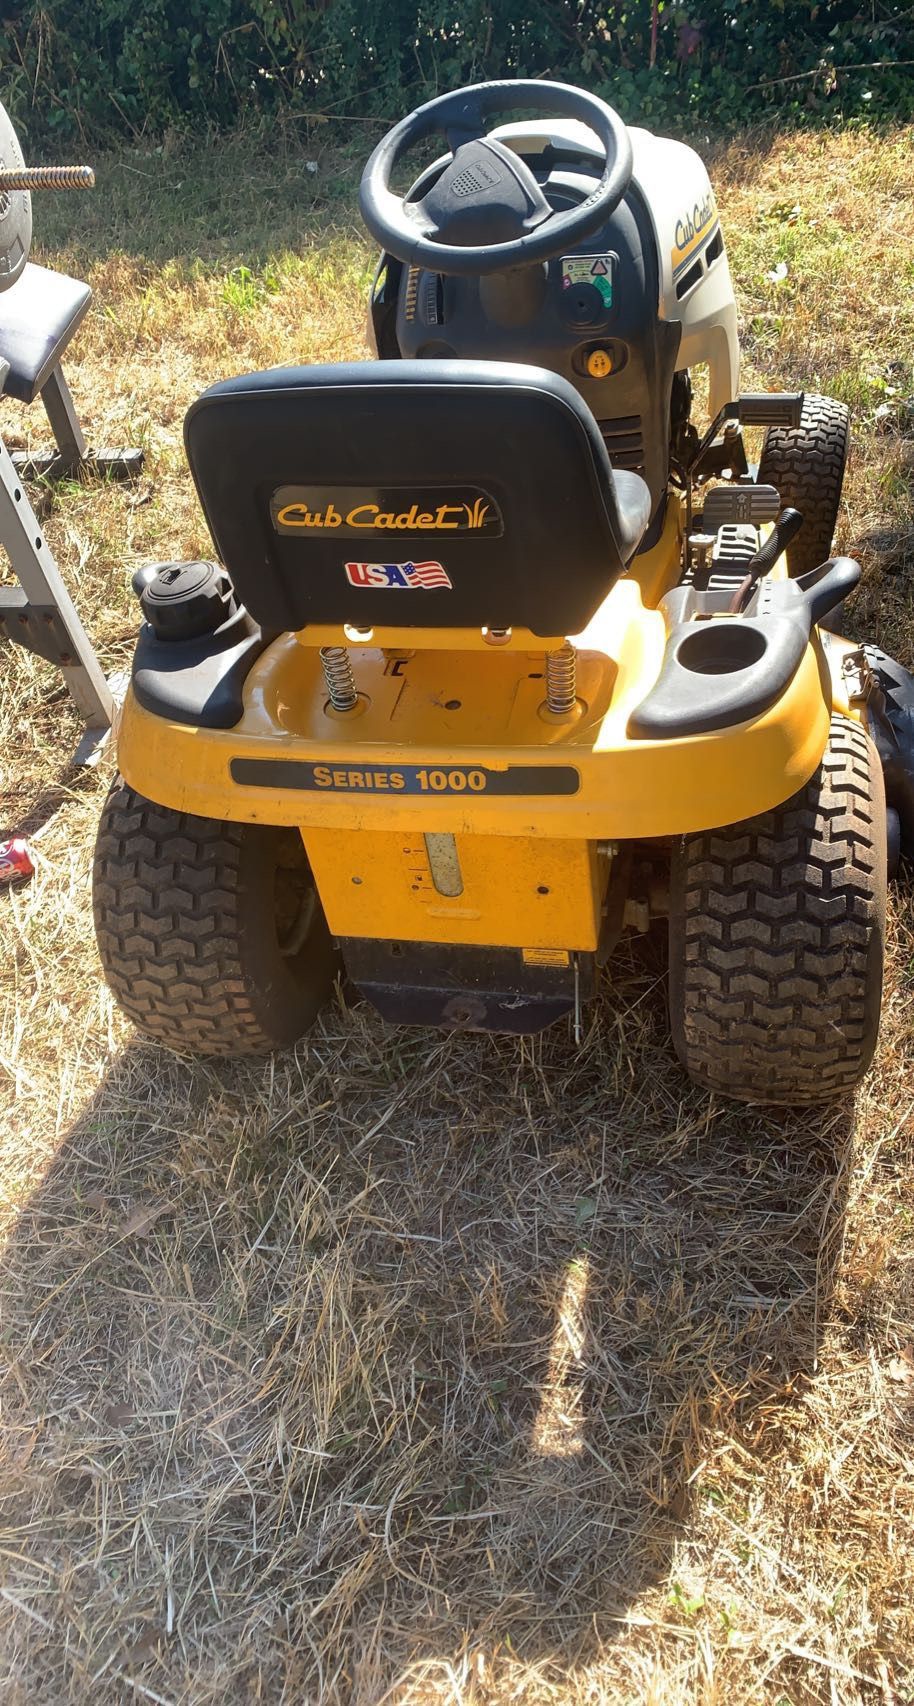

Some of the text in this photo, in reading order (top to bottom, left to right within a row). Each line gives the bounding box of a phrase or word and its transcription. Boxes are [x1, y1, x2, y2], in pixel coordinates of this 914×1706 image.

[675, 211, 695, 251] Cub
[277, 503, 464, 529] Cub Cadet
[347, 563, 409, 586] USA
[313, 767, 487, 791] SERIES 1000
